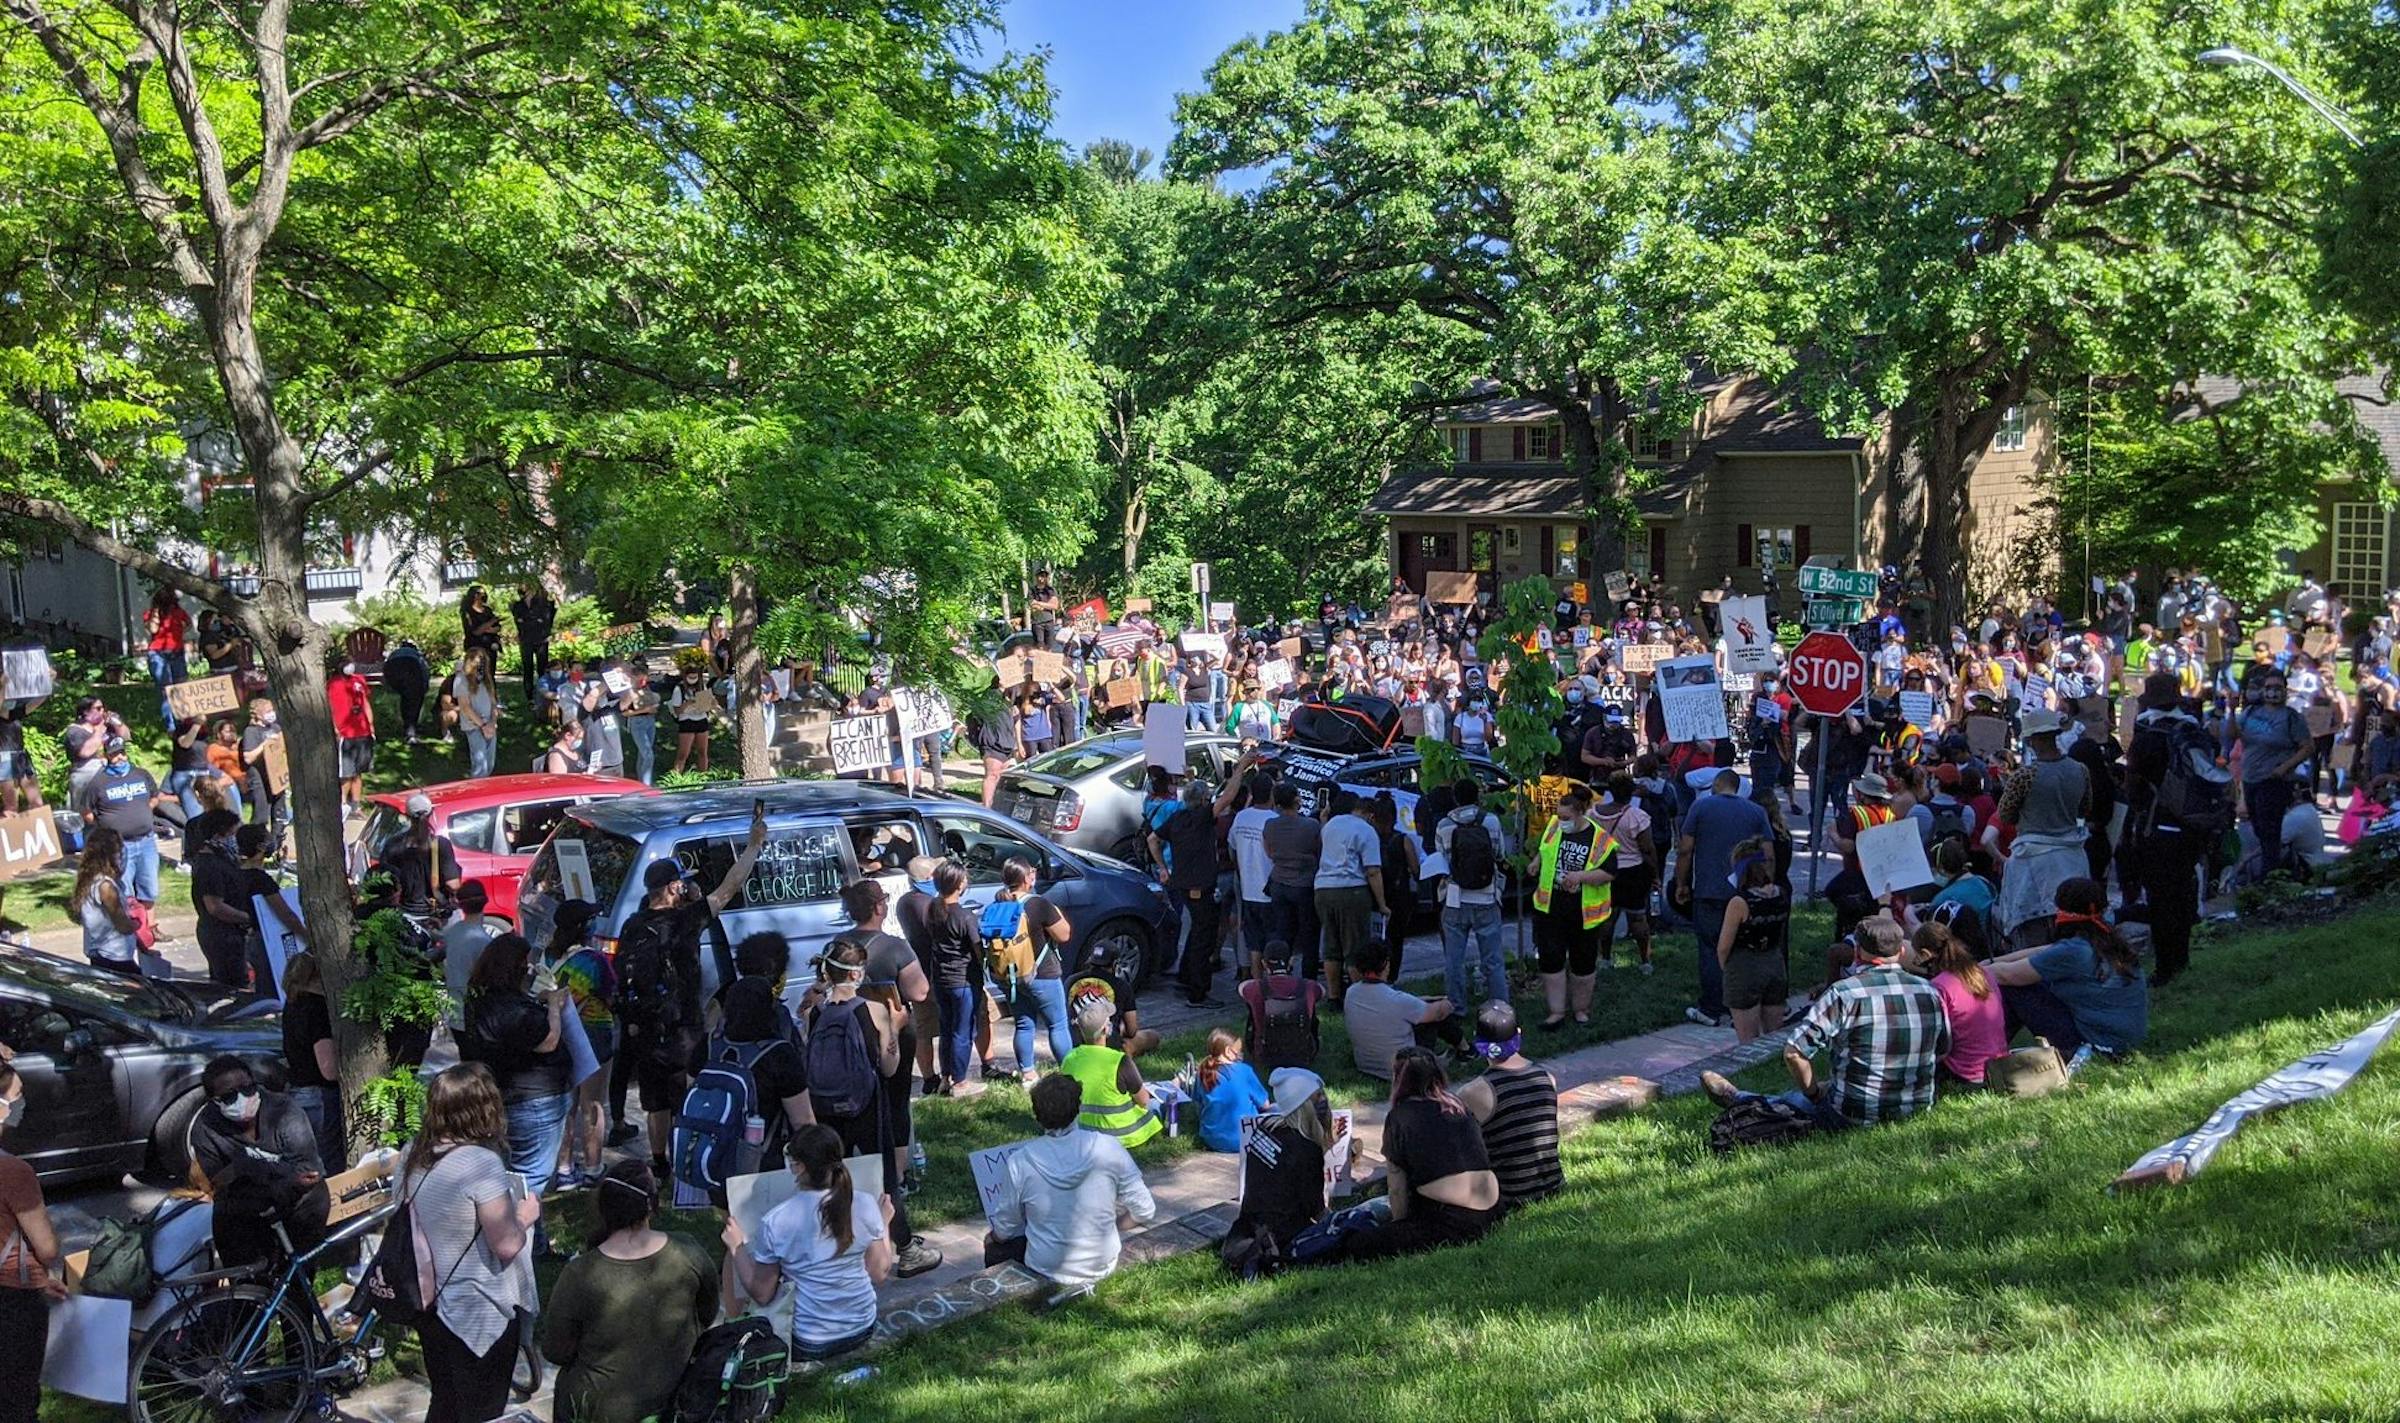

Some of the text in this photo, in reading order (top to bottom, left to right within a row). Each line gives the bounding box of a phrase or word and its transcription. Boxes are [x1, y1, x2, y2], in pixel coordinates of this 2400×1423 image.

[1803, 571, 1875, 593] W 52nd St
[1811, 605, 1817, 620] S
[1820, 604, 1846, 621] Oliver
[1792, 655, 1860, 691] STOP
[189, 680, 227, 696] JUSTICE
[1601, 686, 1633, 701] ACK
[195, 695, 227, 712] PEACE
[832, 721, 846, 740] I
[833, 736, 891, 769] BREATHE
[1284, 766, 1295, 776] 4
[0, 817, 57, 863] LM
[1560, 840, 1589, 855] ATINO
[786, 865, 796, 880] 4
[745, 873, 817, 903] GEORGE
